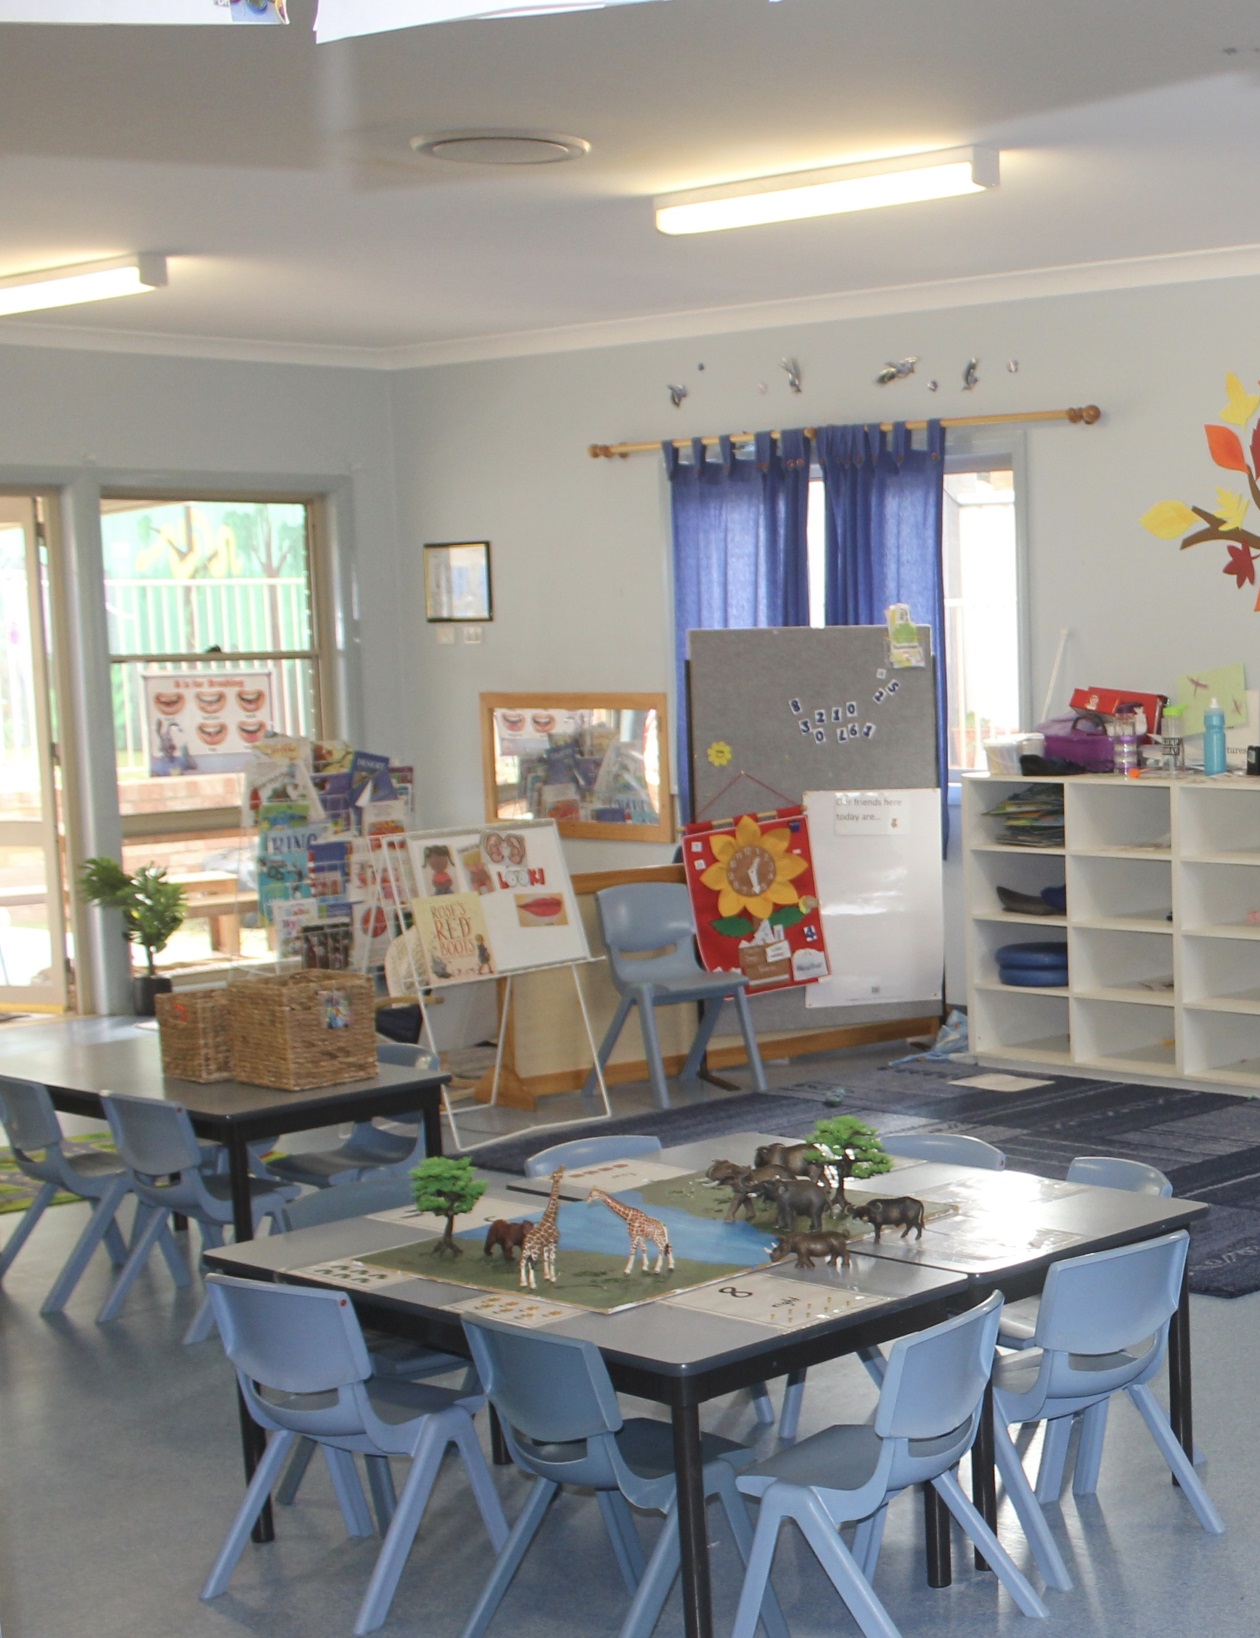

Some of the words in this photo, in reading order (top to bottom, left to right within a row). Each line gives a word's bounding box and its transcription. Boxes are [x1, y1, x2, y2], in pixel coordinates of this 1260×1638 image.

[884, 798, 902, 806] here
[836, 813, 859, 821] today
[434, 917, 472, 940] RED
